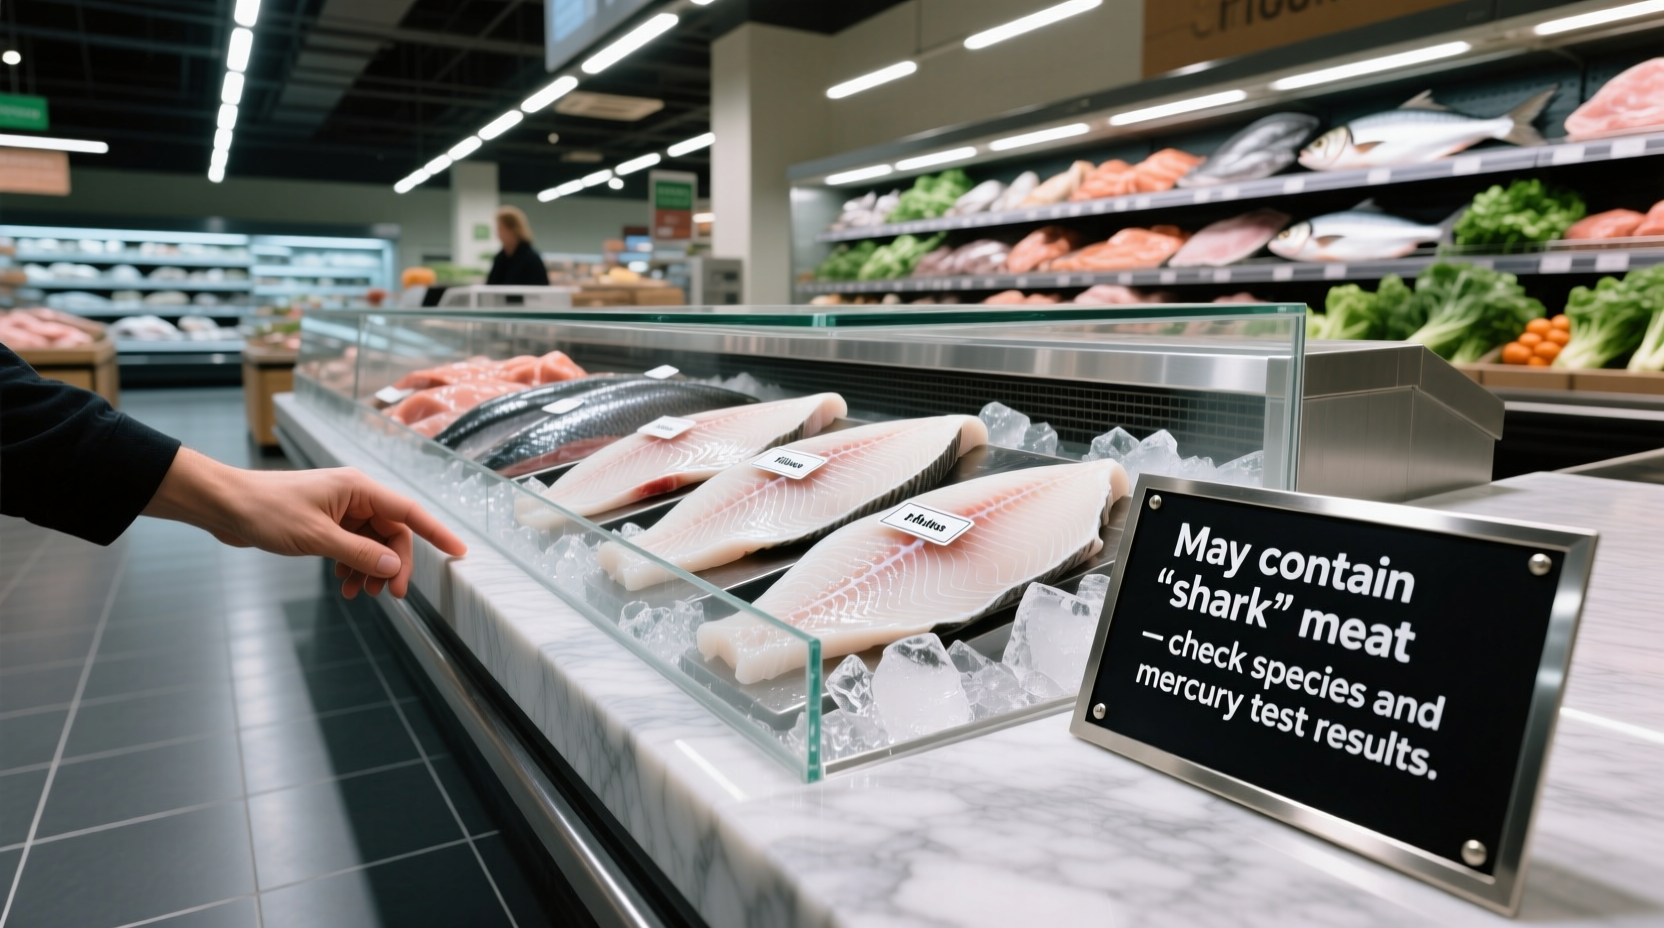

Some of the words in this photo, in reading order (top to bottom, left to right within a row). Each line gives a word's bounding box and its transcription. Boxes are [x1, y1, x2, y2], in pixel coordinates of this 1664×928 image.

[1173, 522, 1253, 579] May
[1258, 547, 1415, 604] contain
[1168, 629, 1248, 674] check
[1250, 655, 1368, 708] species
[1372, 690, 1446, 731] and
[1298, 608, 1416, 664] meat
[1135, 663, 1245, 721] mercury
[1250, 693, 1309, 738] test
[1313, 718, 1437, 780] results.
